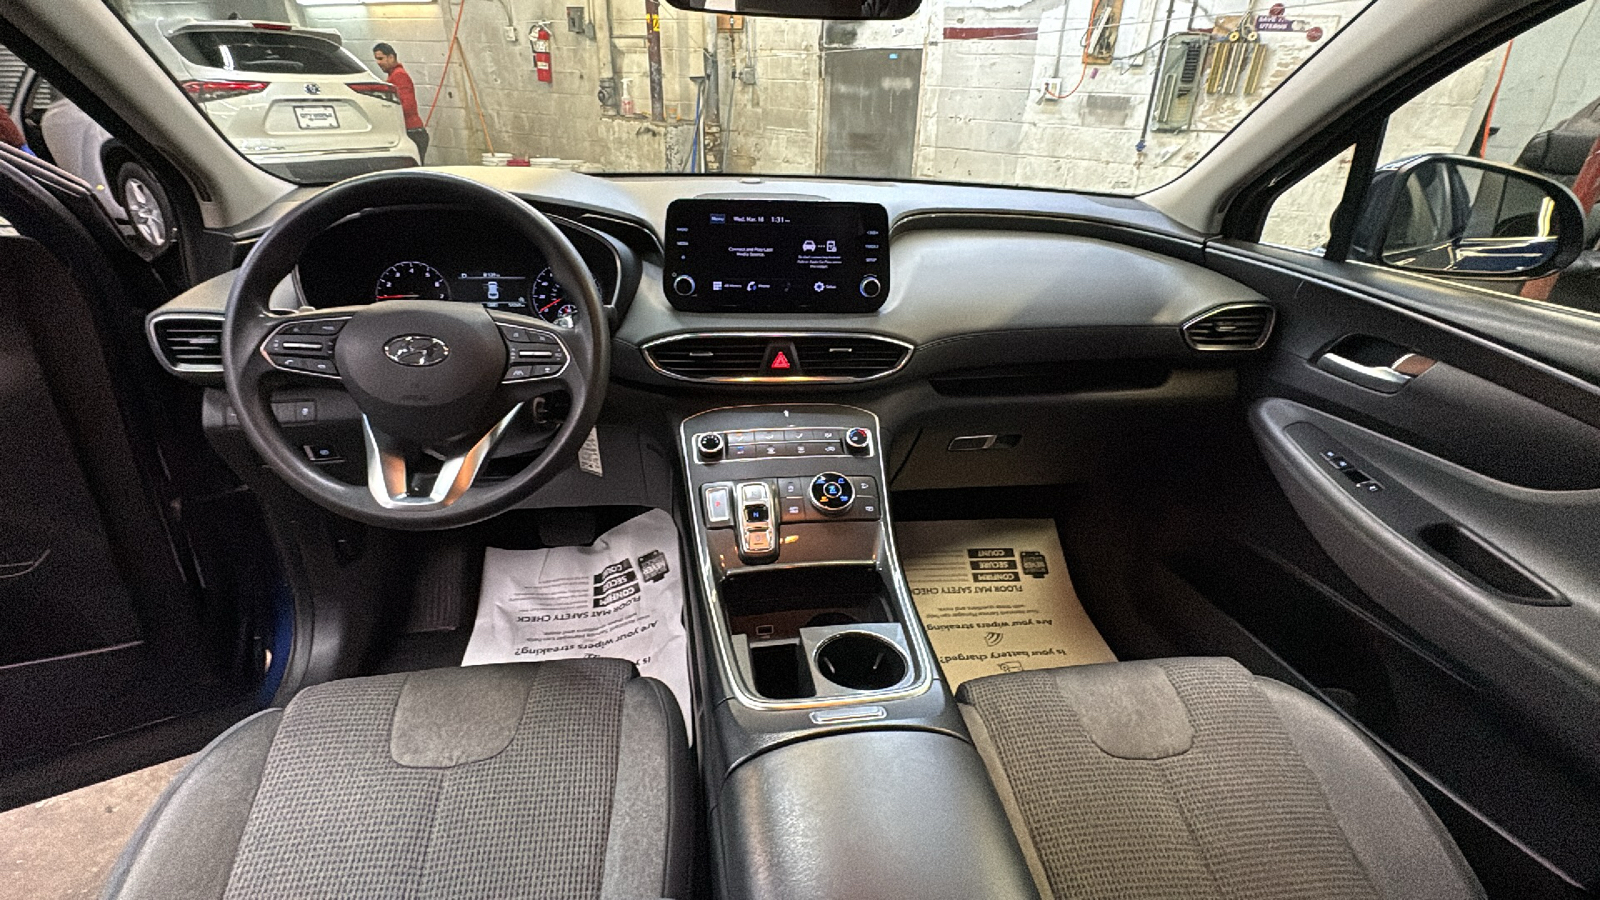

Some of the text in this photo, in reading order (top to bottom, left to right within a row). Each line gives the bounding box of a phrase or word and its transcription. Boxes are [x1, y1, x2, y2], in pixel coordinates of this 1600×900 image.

[979, 561, 1009, 569] SECURE
[941, 586, 972, 594] SAFETY
[974, 585, 993, 593] MAT
[994, 585, 1024, 593] FLOOR
[517, 596, 641, 623] FLOOR MAT SAFETY CHECK
[925, 622, 974, 631] streaking
[976, 620, 1010, 629] wipers
[1011, 618, 1035, 627] your
[514, 620, 658, 656] Are your wipers streaking?
[990, 651, 1030, 659] battery
[1031, 648, 1055, 656] your
[940, 653, 988, 663] charged?
